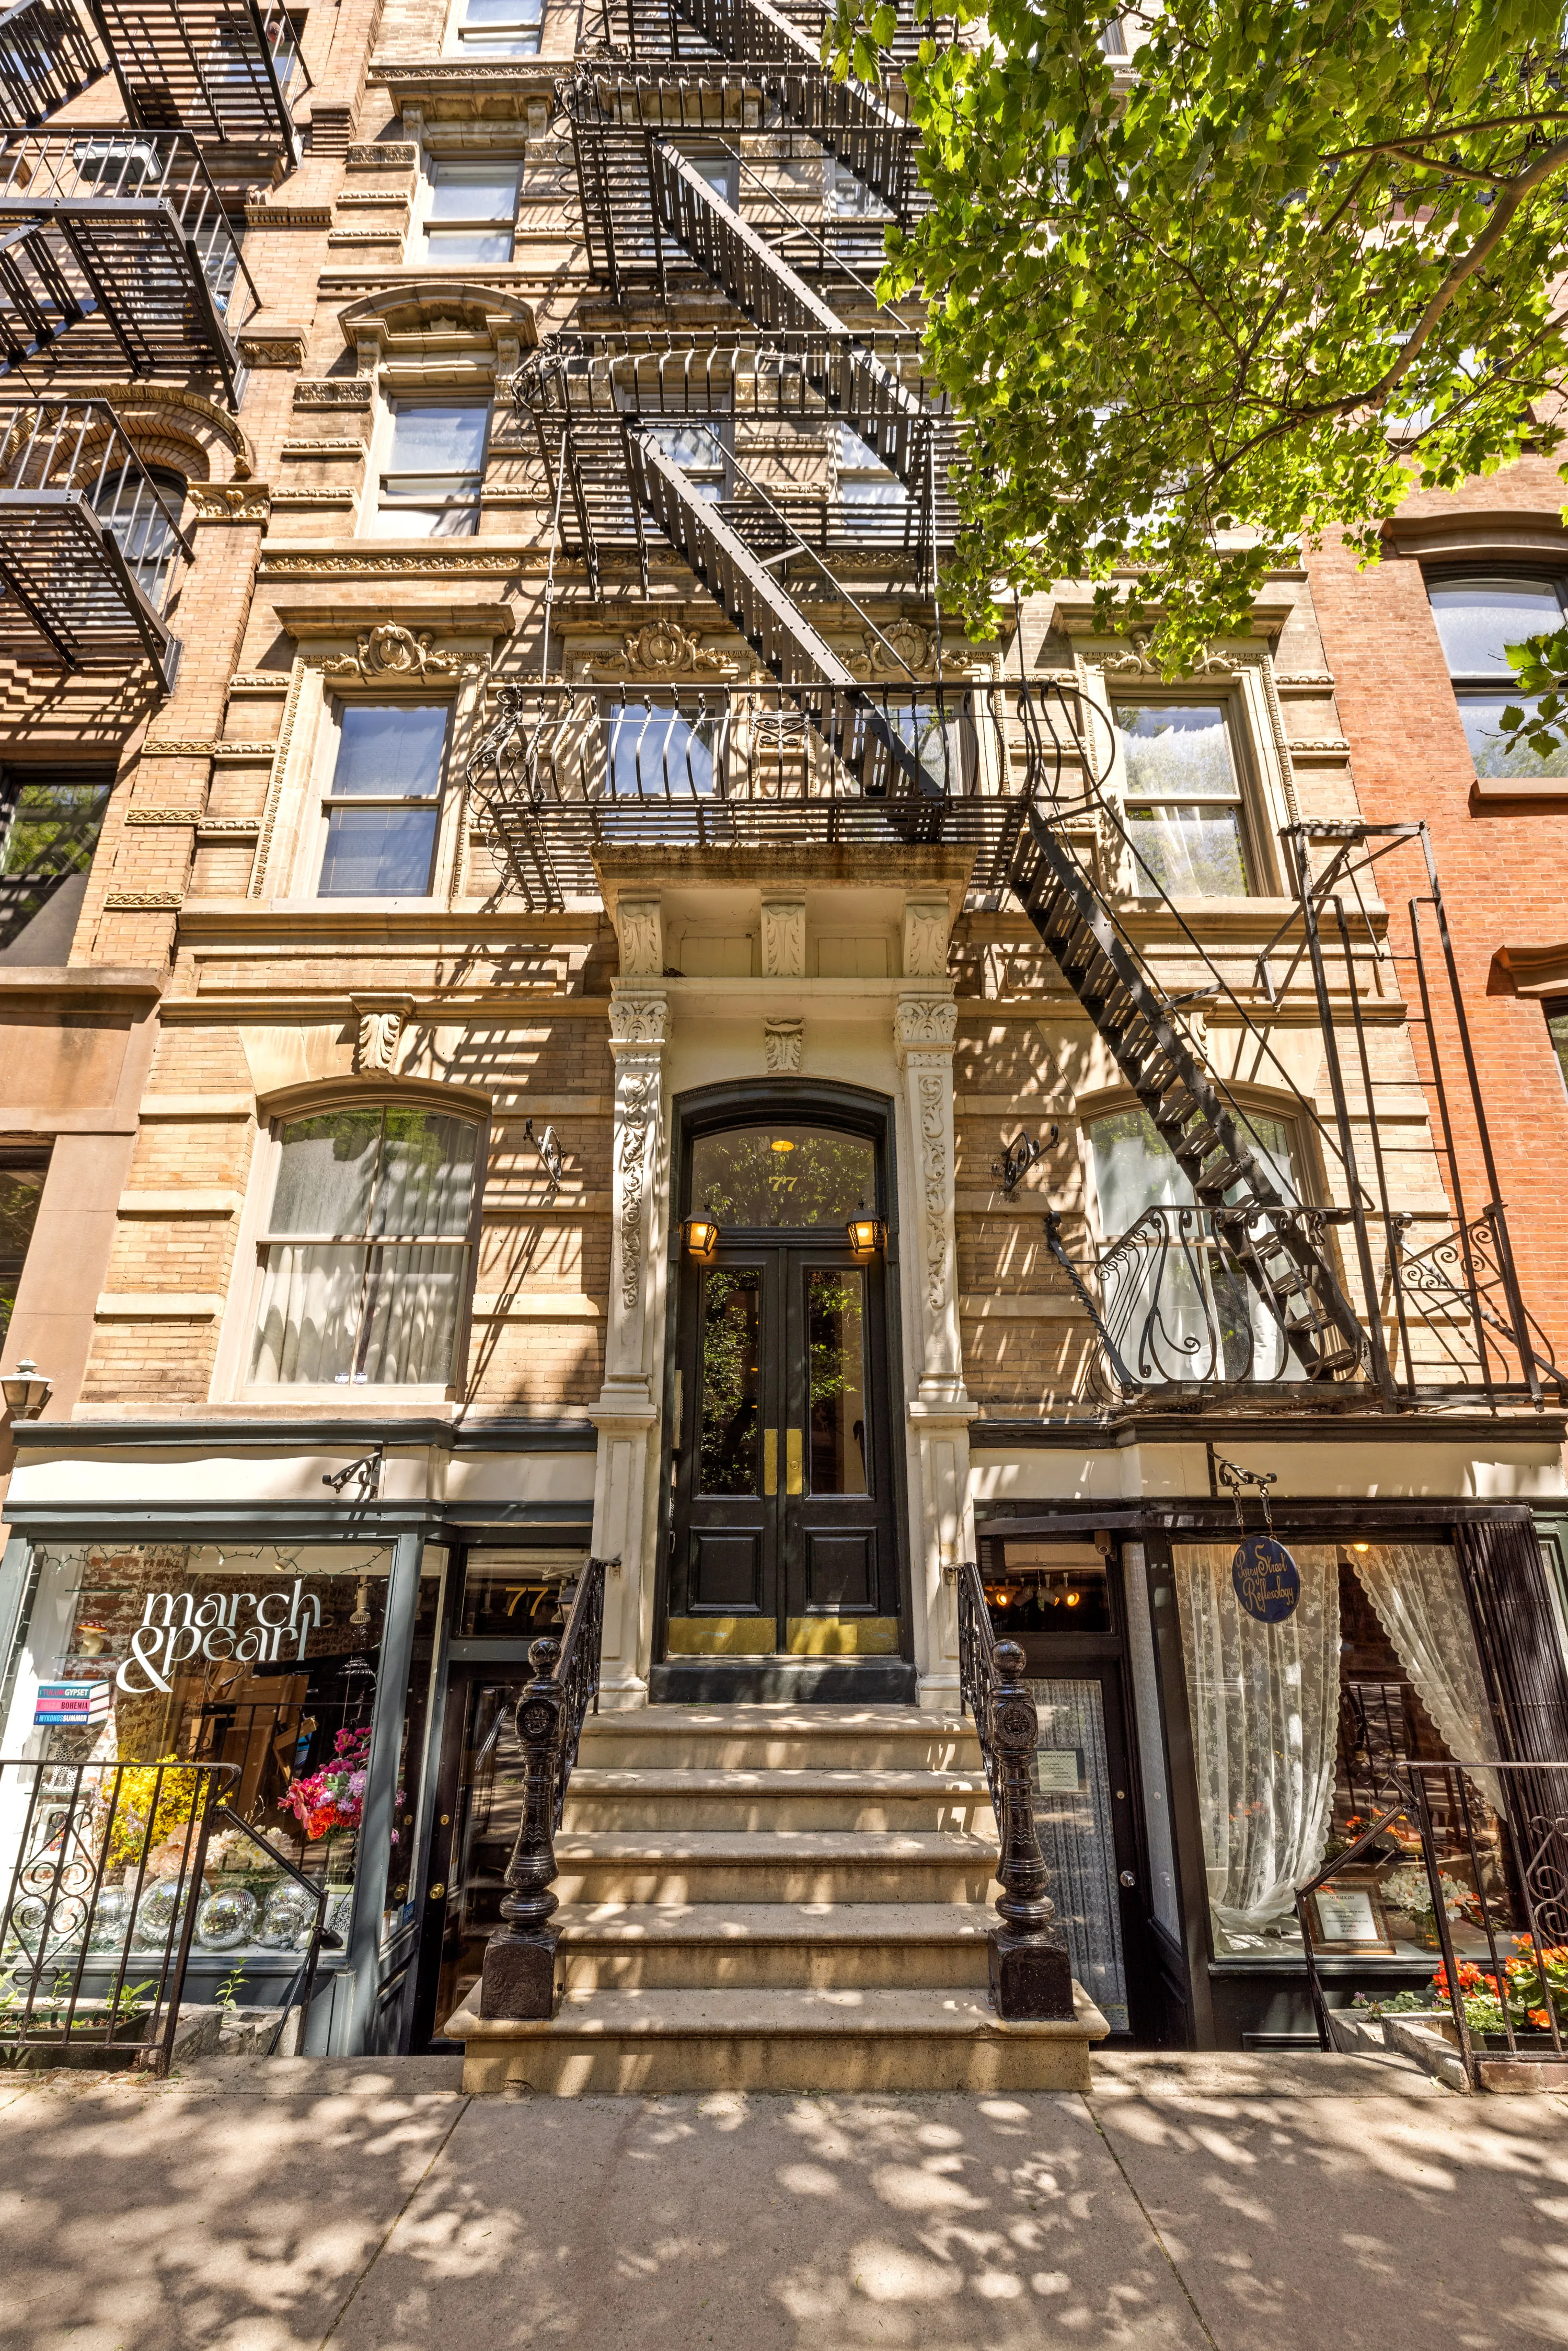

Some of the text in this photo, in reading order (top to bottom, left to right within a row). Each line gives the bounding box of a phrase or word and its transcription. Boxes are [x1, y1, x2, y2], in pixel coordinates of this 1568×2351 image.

[768, 1176, 798, 1192] 77
[1235, 1543, 1288, 1585] Perry Street
[140, 1578, 321, 1628] march
[505, 1587, 549, 1617] 77
[1242, 1575, 1294, 1612] Reflexology
[162, 1611, 310, 1677] pearl
